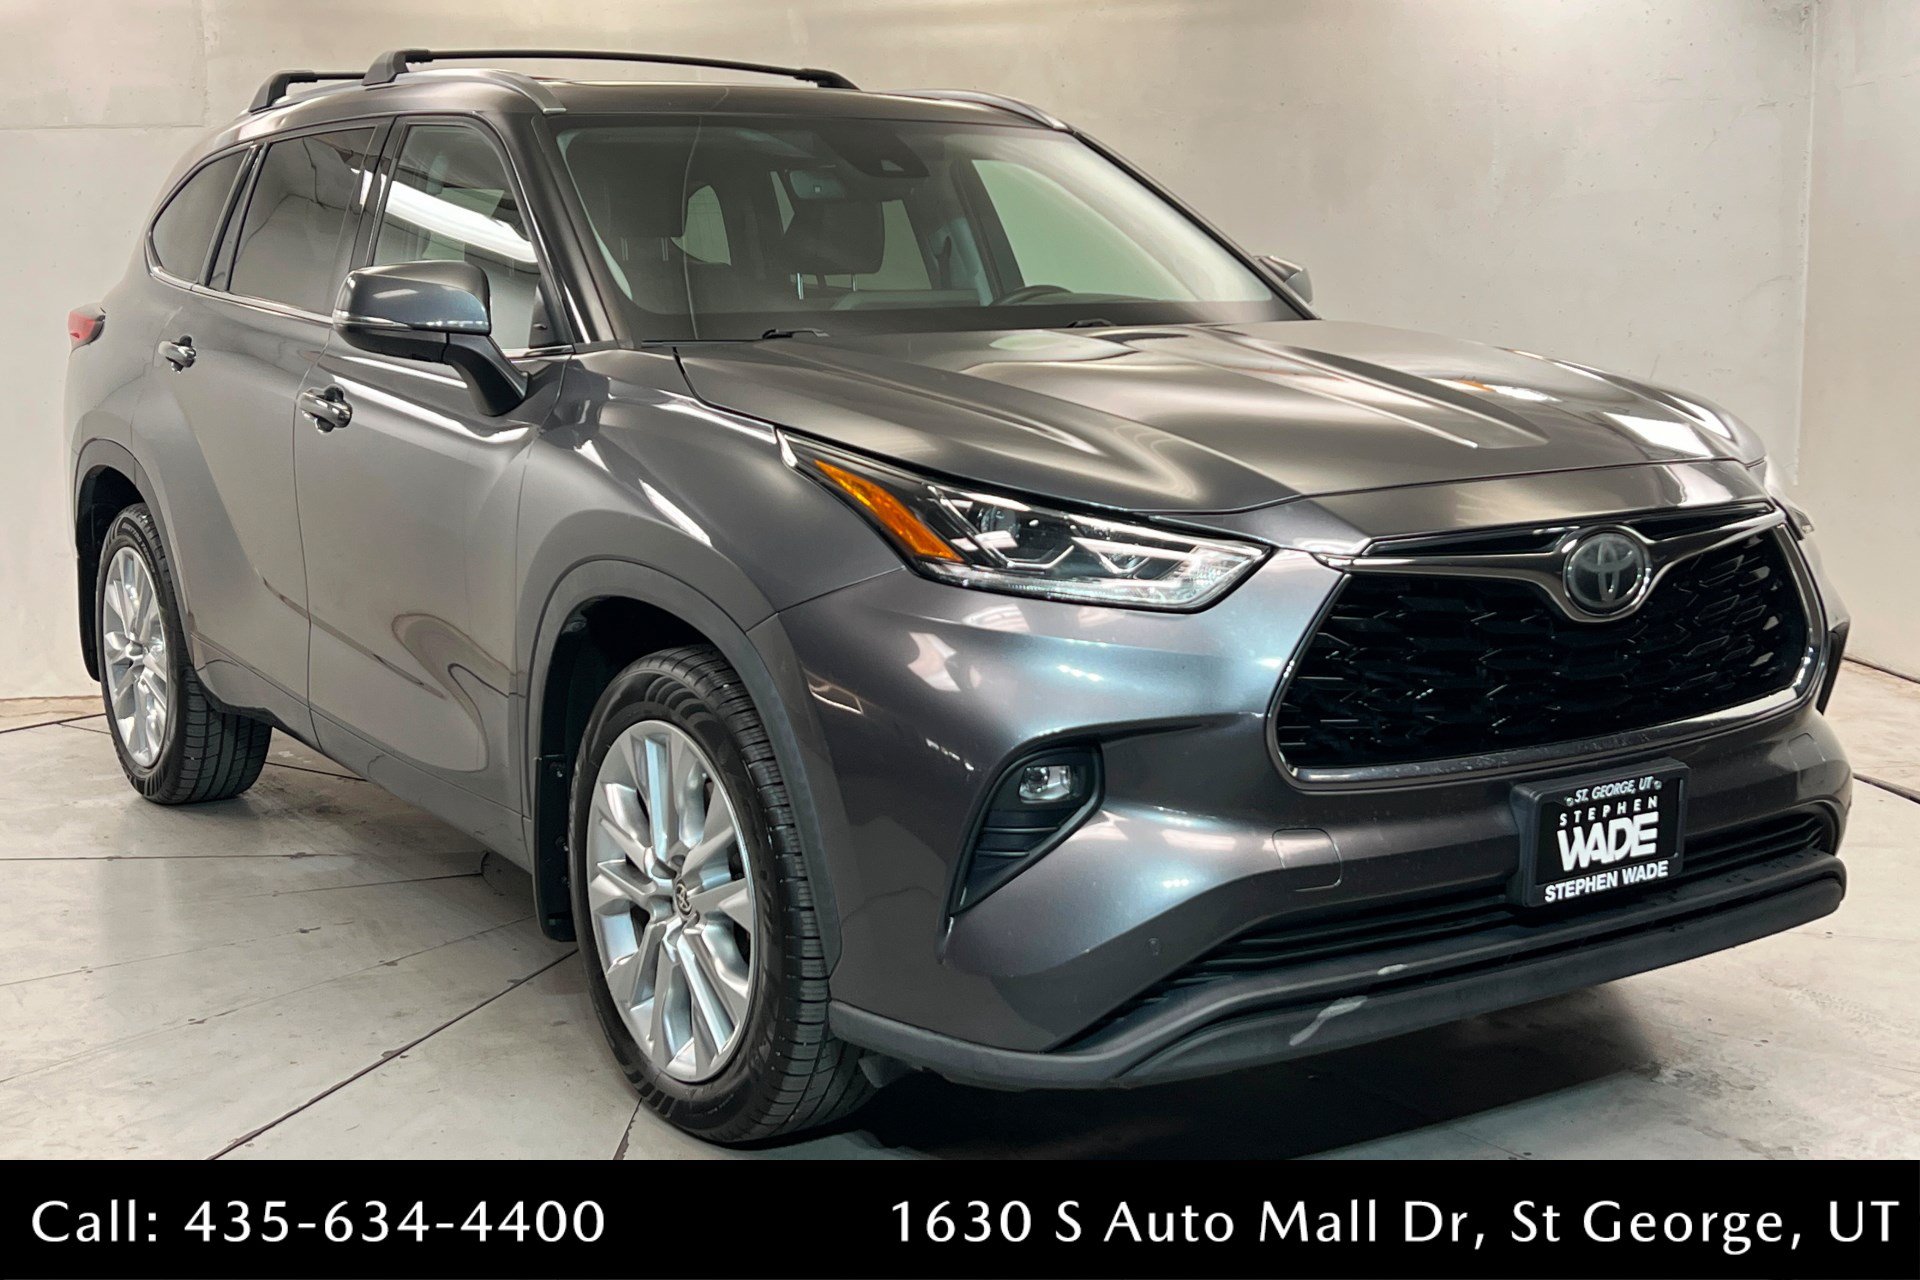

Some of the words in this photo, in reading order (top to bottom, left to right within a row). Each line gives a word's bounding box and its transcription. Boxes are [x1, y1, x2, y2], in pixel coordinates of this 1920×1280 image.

[1591, 780, 1636, 799] GEORGE,
[1638, 776, 1653, 790] UT
[1559, 796, 1658, 827] STEPHEN
[1556, 811, 1659, 871] WADE
[1544, 871, 1618, 902] STEPHEN
[1621, 860, 1668, 885] WADE
